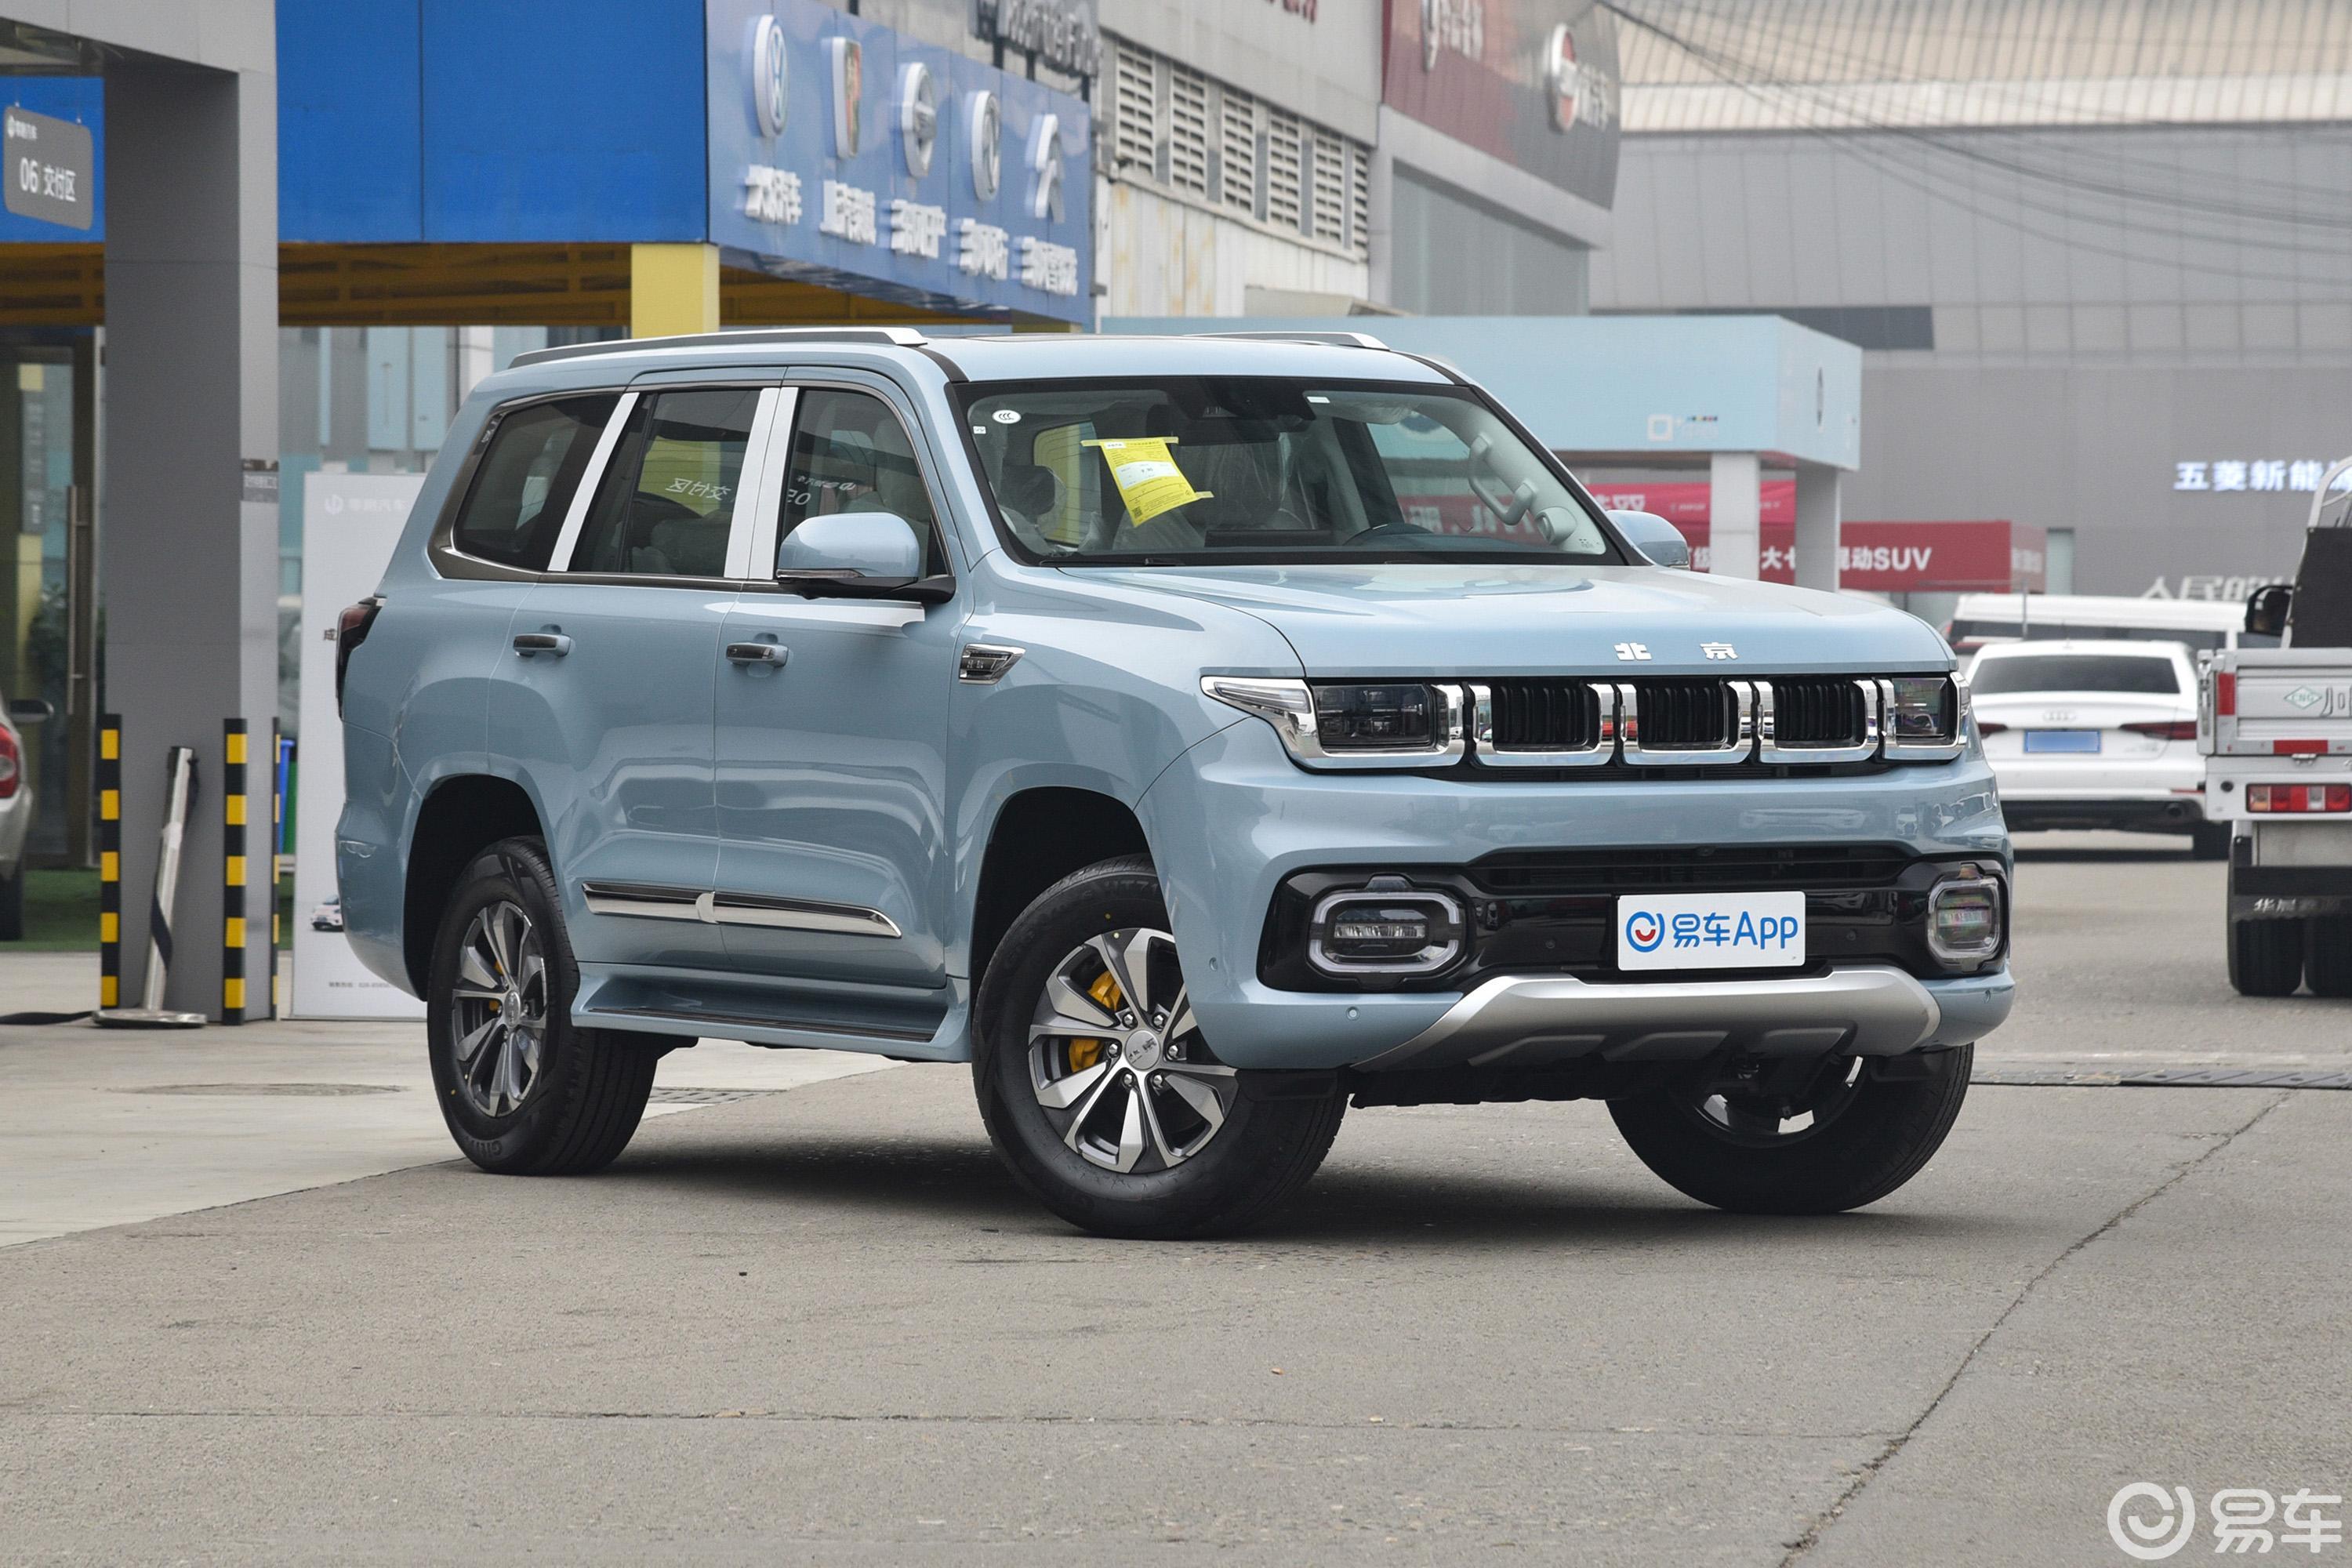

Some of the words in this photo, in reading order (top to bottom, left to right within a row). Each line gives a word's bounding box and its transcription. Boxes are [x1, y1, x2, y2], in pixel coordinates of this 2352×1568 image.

[20, 157, 39, 194] 06
[43, 164, 77, 202] 交付区
[1671, 910, 1798, 950] 易车App
